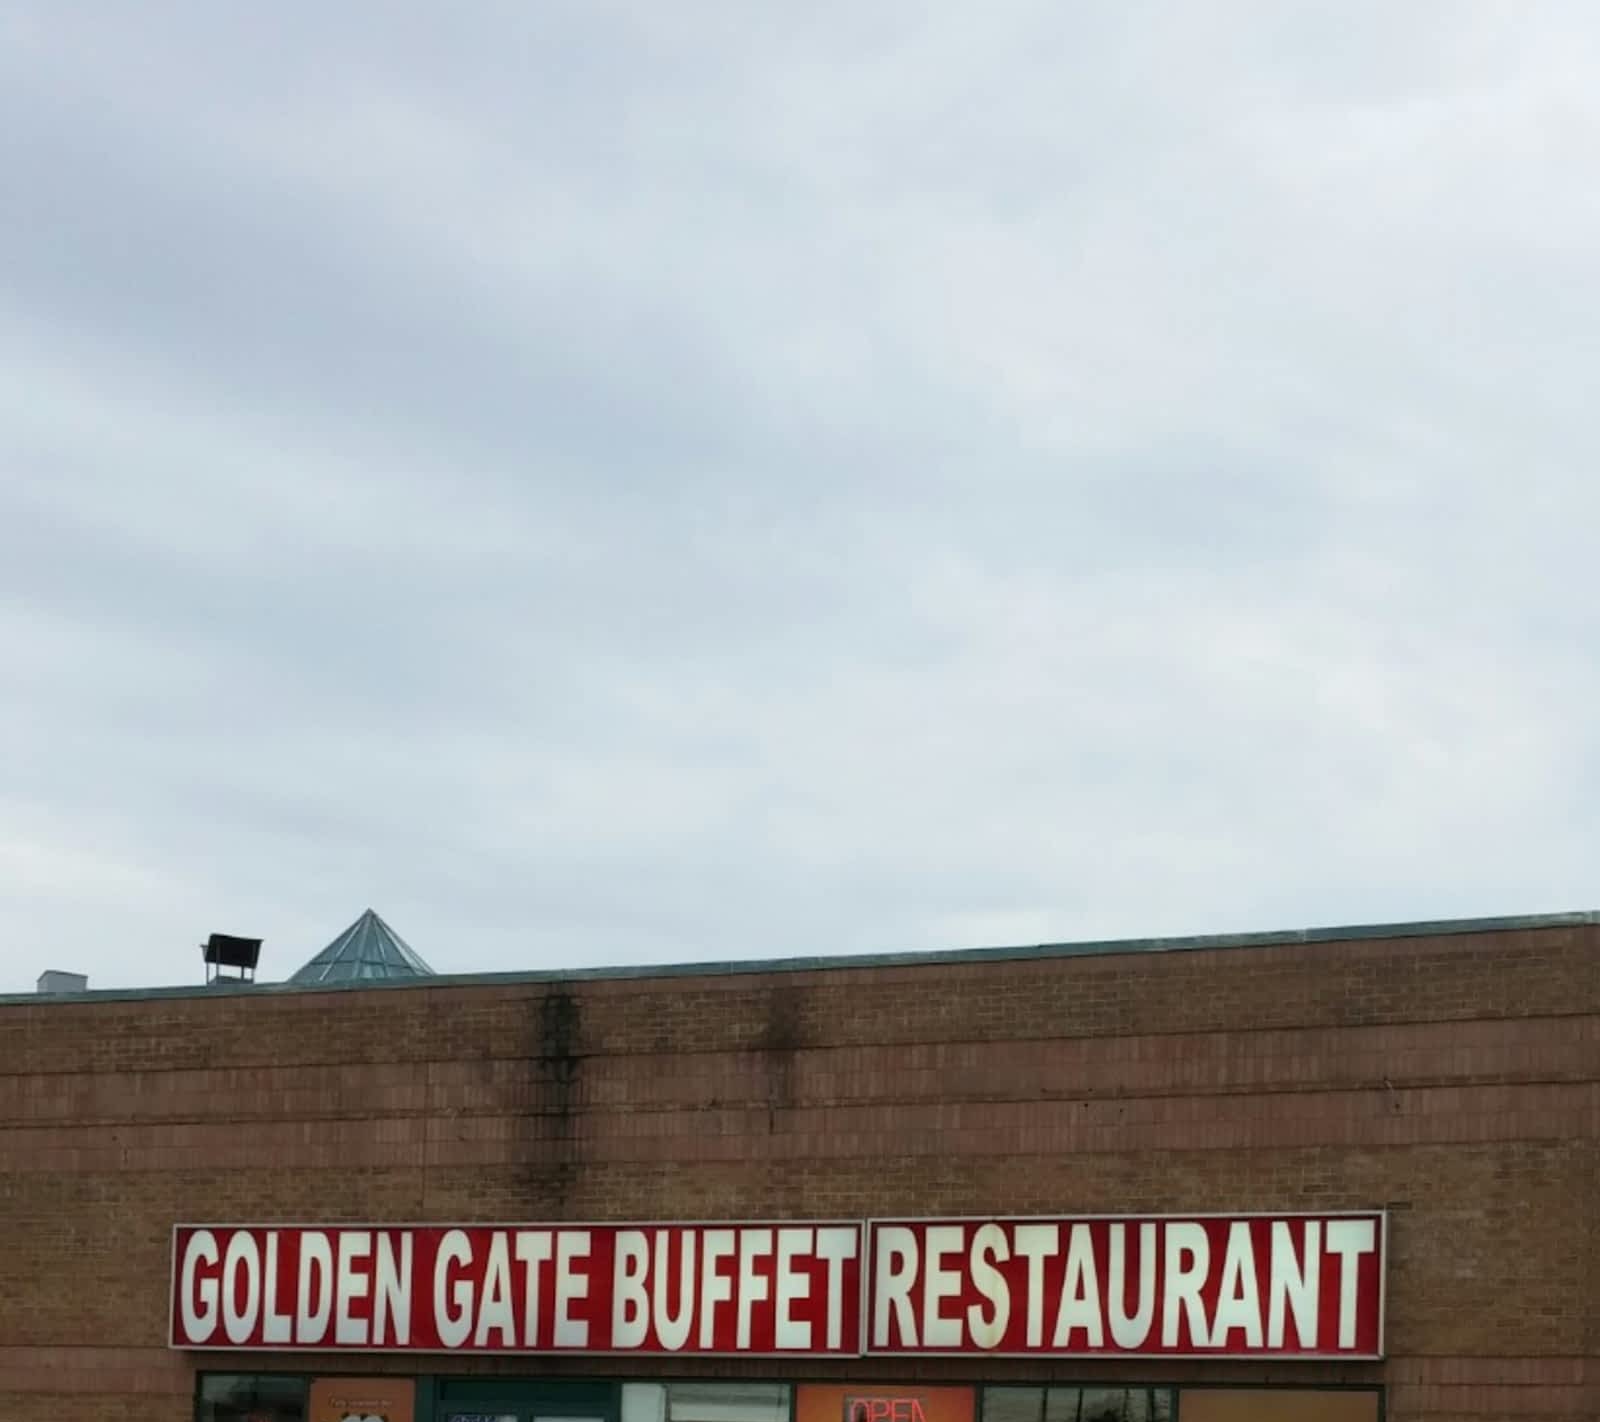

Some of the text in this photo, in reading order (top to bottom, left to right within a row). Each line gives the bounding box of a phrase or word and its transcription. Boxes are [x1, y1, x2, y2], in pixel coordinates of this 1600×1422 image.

[181, 1220, 1376, 1351] GOLDEN GATE BUFFET RESTAURANT
